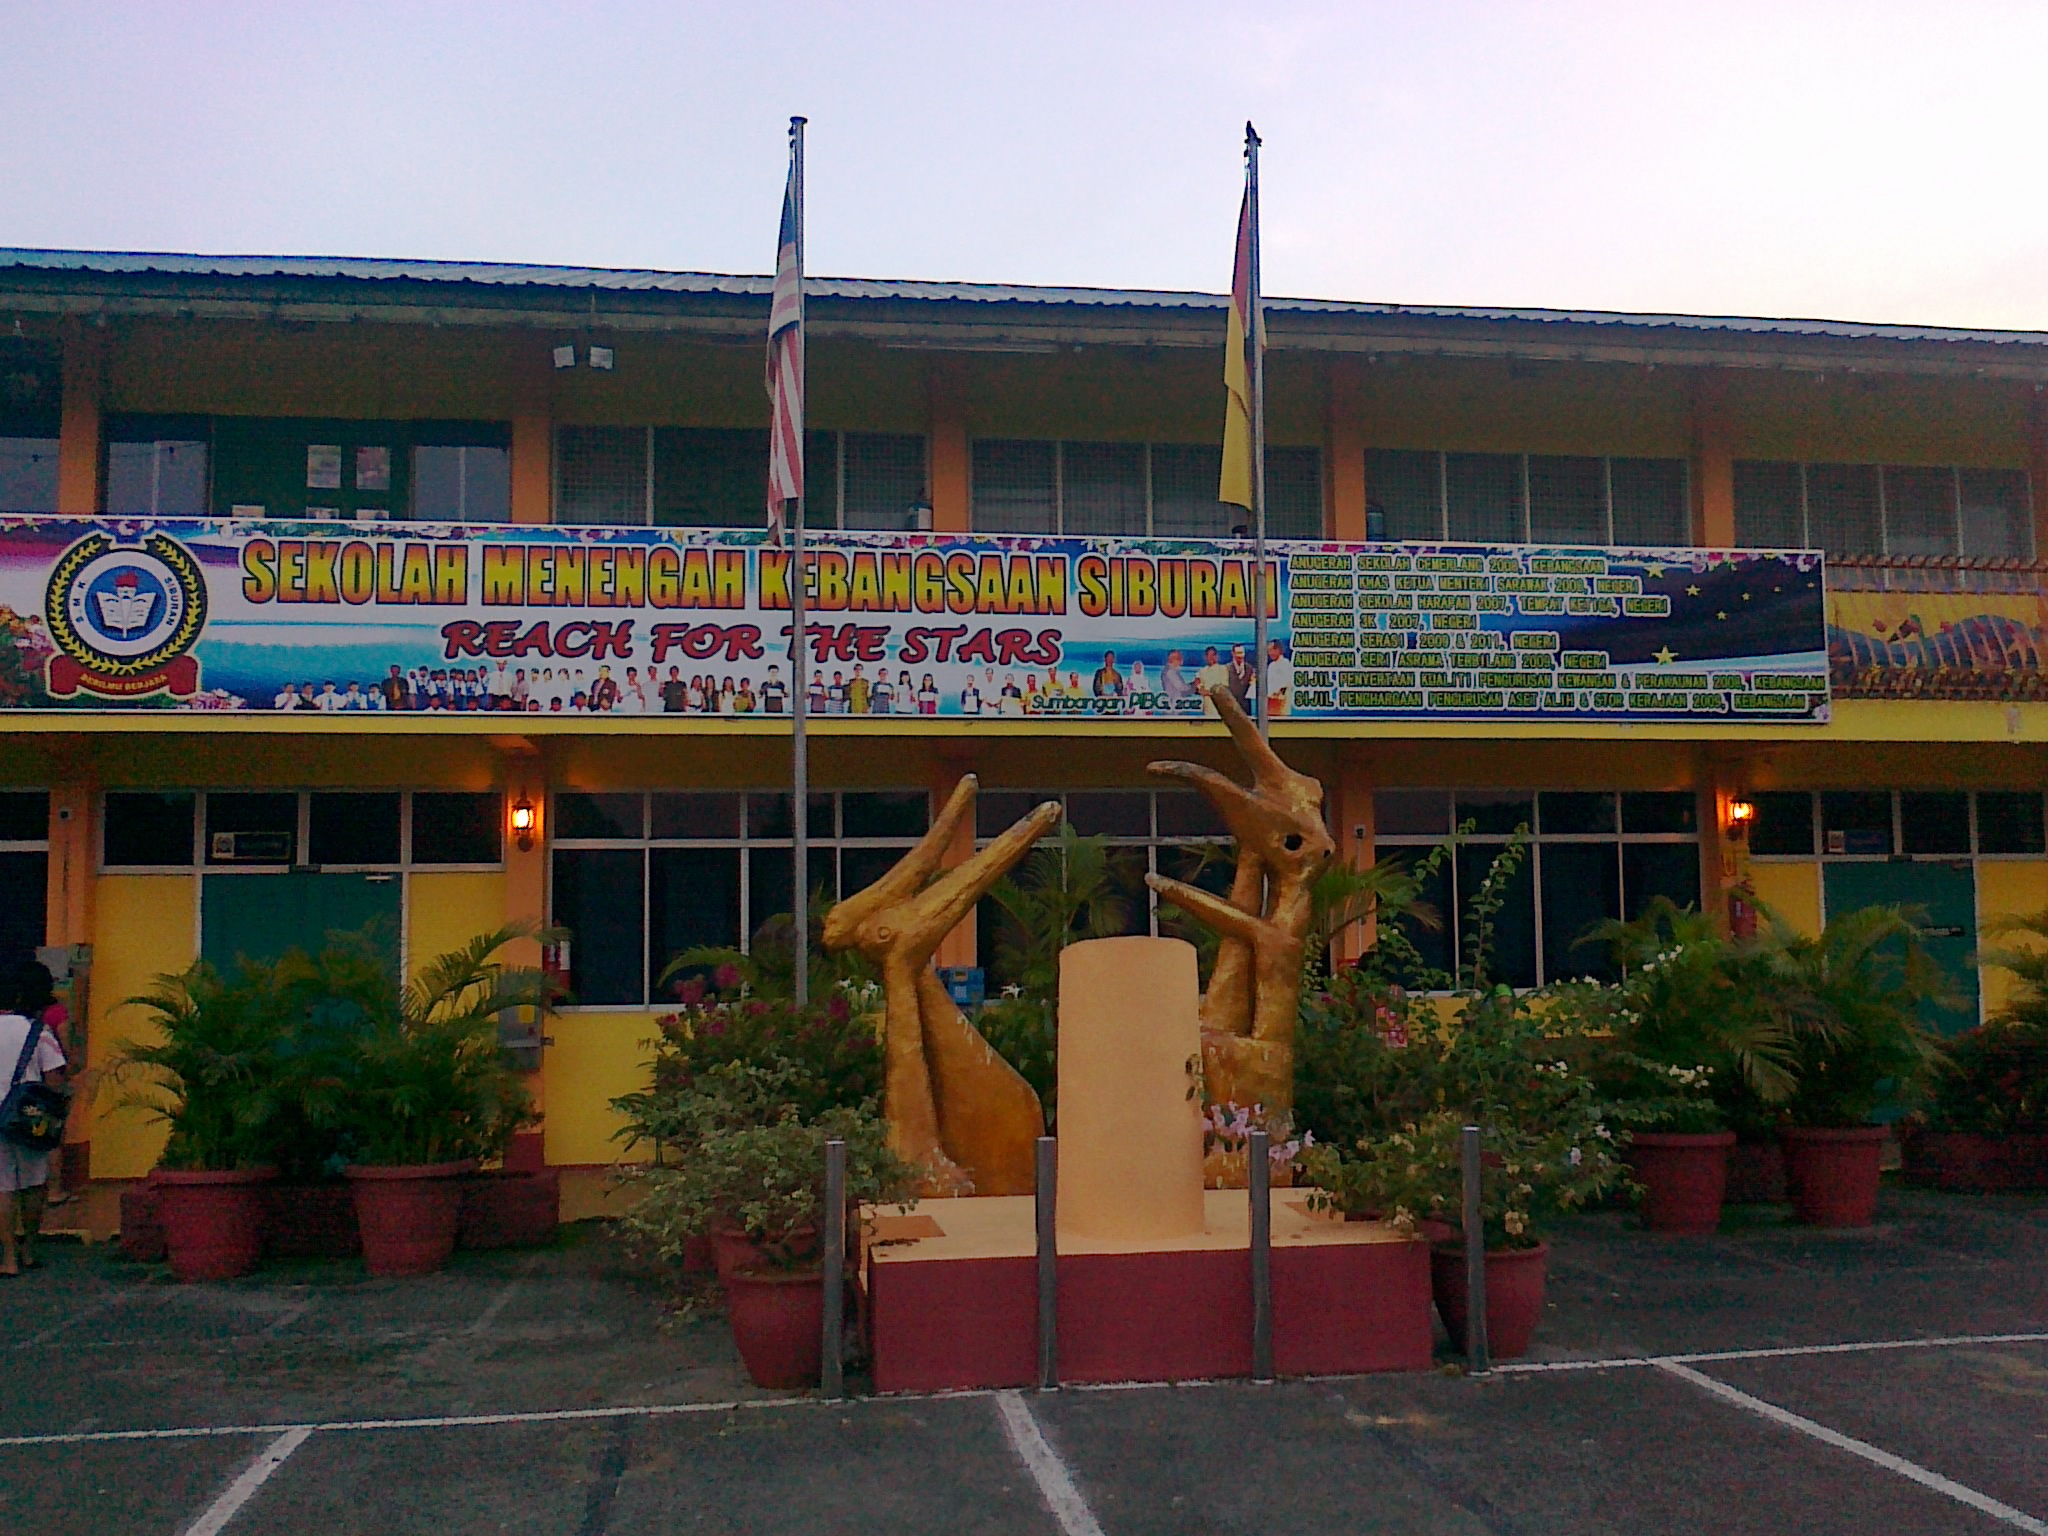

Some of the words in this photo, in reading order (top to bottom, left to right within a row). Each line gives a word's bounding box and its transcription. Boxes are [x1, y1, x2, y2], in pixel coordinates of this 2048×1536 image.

[1290, 555, 1352, 570] ANUGERAH
[1358, 555, 1411, 571] SEKOLAH
[1532, 558, 1605, 574] KEBANGSAAN
[242, 539, 469, 606] SEKOLAH
[481, 544, 746, 609] MENENGAH
[759, 549, 1067, 617] KEBANGSAAN
[1078, 555, 1279, 619] SIBURAN
[1291, 573, 1352, 589] ANUGERAH
[1395, 574, 1434, 590] KETUA
[1439, 575, 1490, 591] MENTERI
[1497, 577, 1549, 593] SARAWAK
[1596, 578, 1639, 594] NEGERI
[1291, 593, 1353, 609] ANUGERAH
[1359, 593, 1412, 610] SEKOLAH
[1417, 594, 1471, 610] HARAPAN
[1520, 596, 1563, 611] TEMPAT
[1625, 597, 1668, 613] NEGERI
[1292, 613, 1354, 629] ANUGERAH
[1433, 613, 1477, 629] NEGERI
[441, 619, 635, 660] REACH
[650, 622, 764, 664] FOR
[780, 621, 891, 663] THE
[899, 624, 1062, 665] STARS
[1293, 632, 1355, 648] ANUGERAH
[1512, 633, 1557, 649] NEGERI
[1293, 651, 1355, 667] ANUGERAH
[1361, 651, 1390, 667] SERI
[1398, 652, 1444, 668] ASRAMA
[1563, 653, 1606, 669] NEGERI
[1294, 671, 1334, 687] SIJIL
[1339, 671, 1416, 687] PENYERTAAN
[1479, 672, 1552, 688] PENGURUSAN
[1754, 675, 1825, 691] KEBANGSAAN
[1032, 694, 1125, 713] Sumbangan
[1294, 691, 1334, 707] SIJIL
[1428, 691, 1503, 707] PENGURUSAN
[1508, 691, 1538, 707] ASET
[1594, 692, 1624, 708] STOR
[1628, 692, 1688, 708] KERAJAAN
[1734, 693, 1806, 709] KEBANGSAAN
